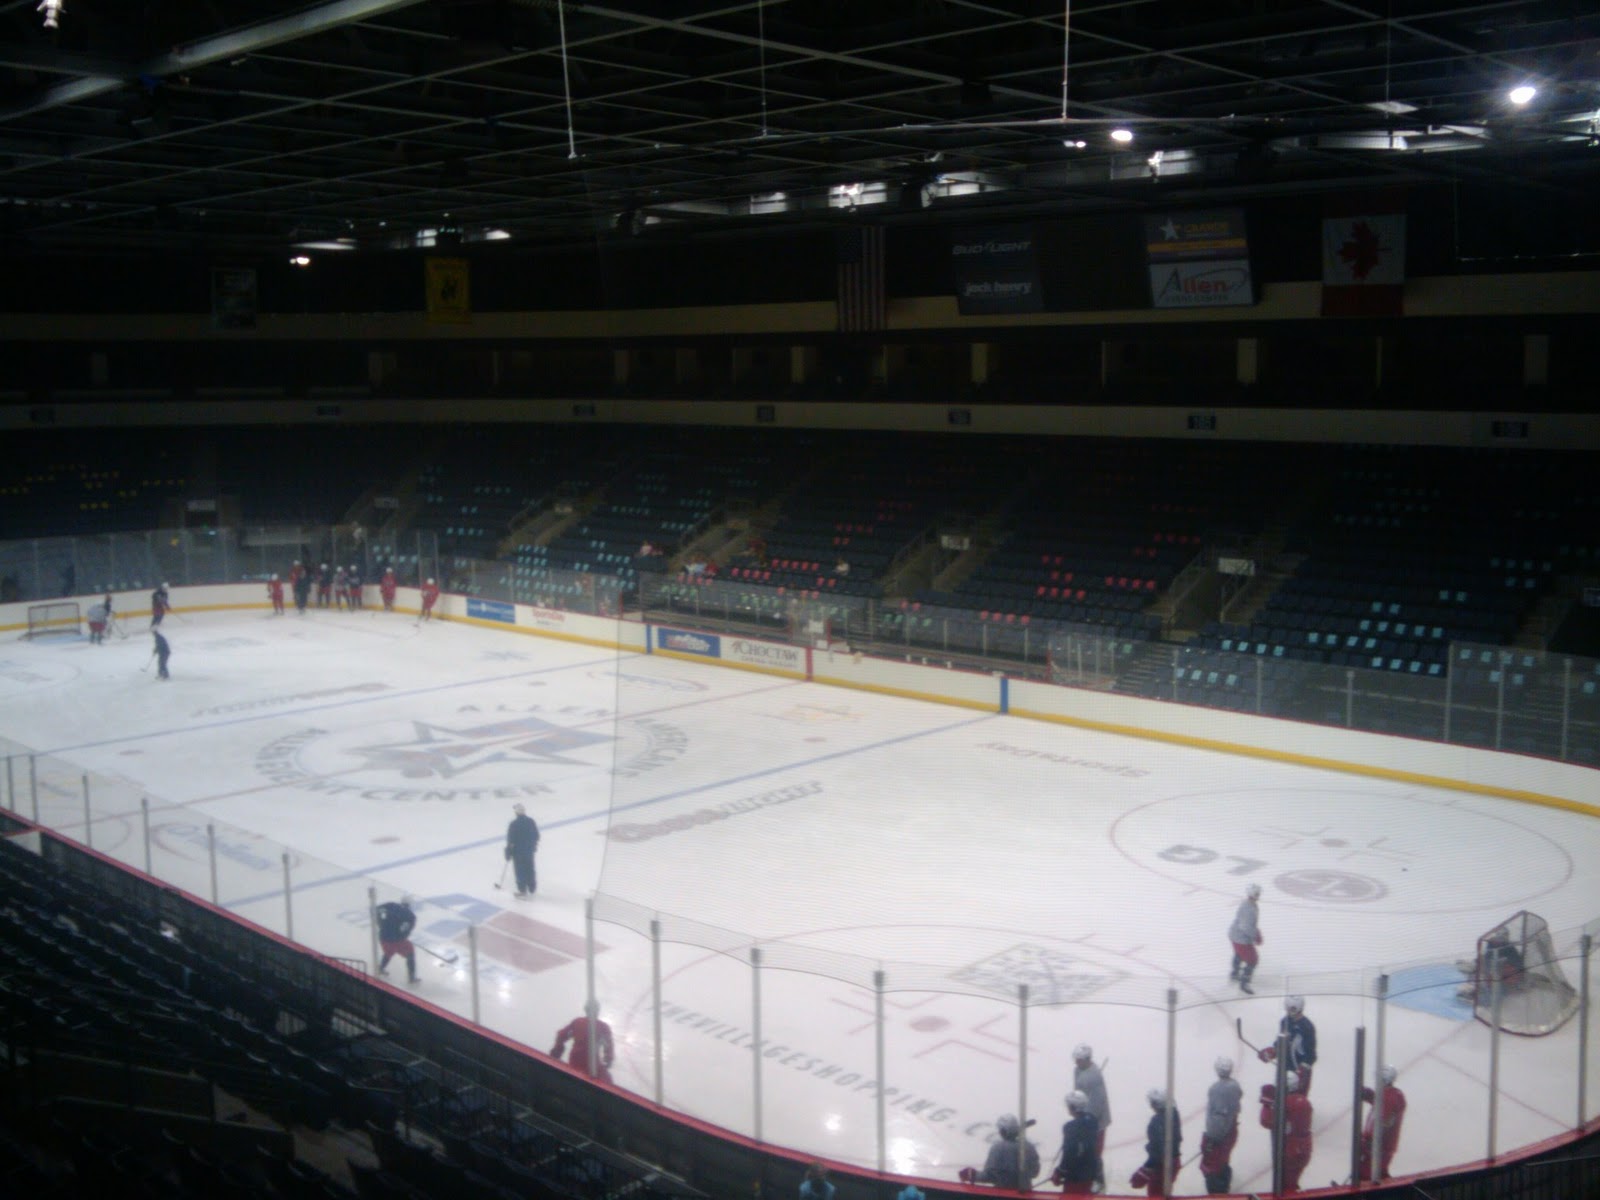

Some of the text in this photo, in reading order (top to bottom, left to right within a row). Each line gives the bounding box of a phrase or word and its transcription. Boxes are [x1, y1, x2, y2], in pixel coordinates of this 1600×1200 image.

[1159, 267, 1232, 298] Allen
[740, 640, 800, 662] CHOCTAW
[360, 784, 553, 801] CENTER
